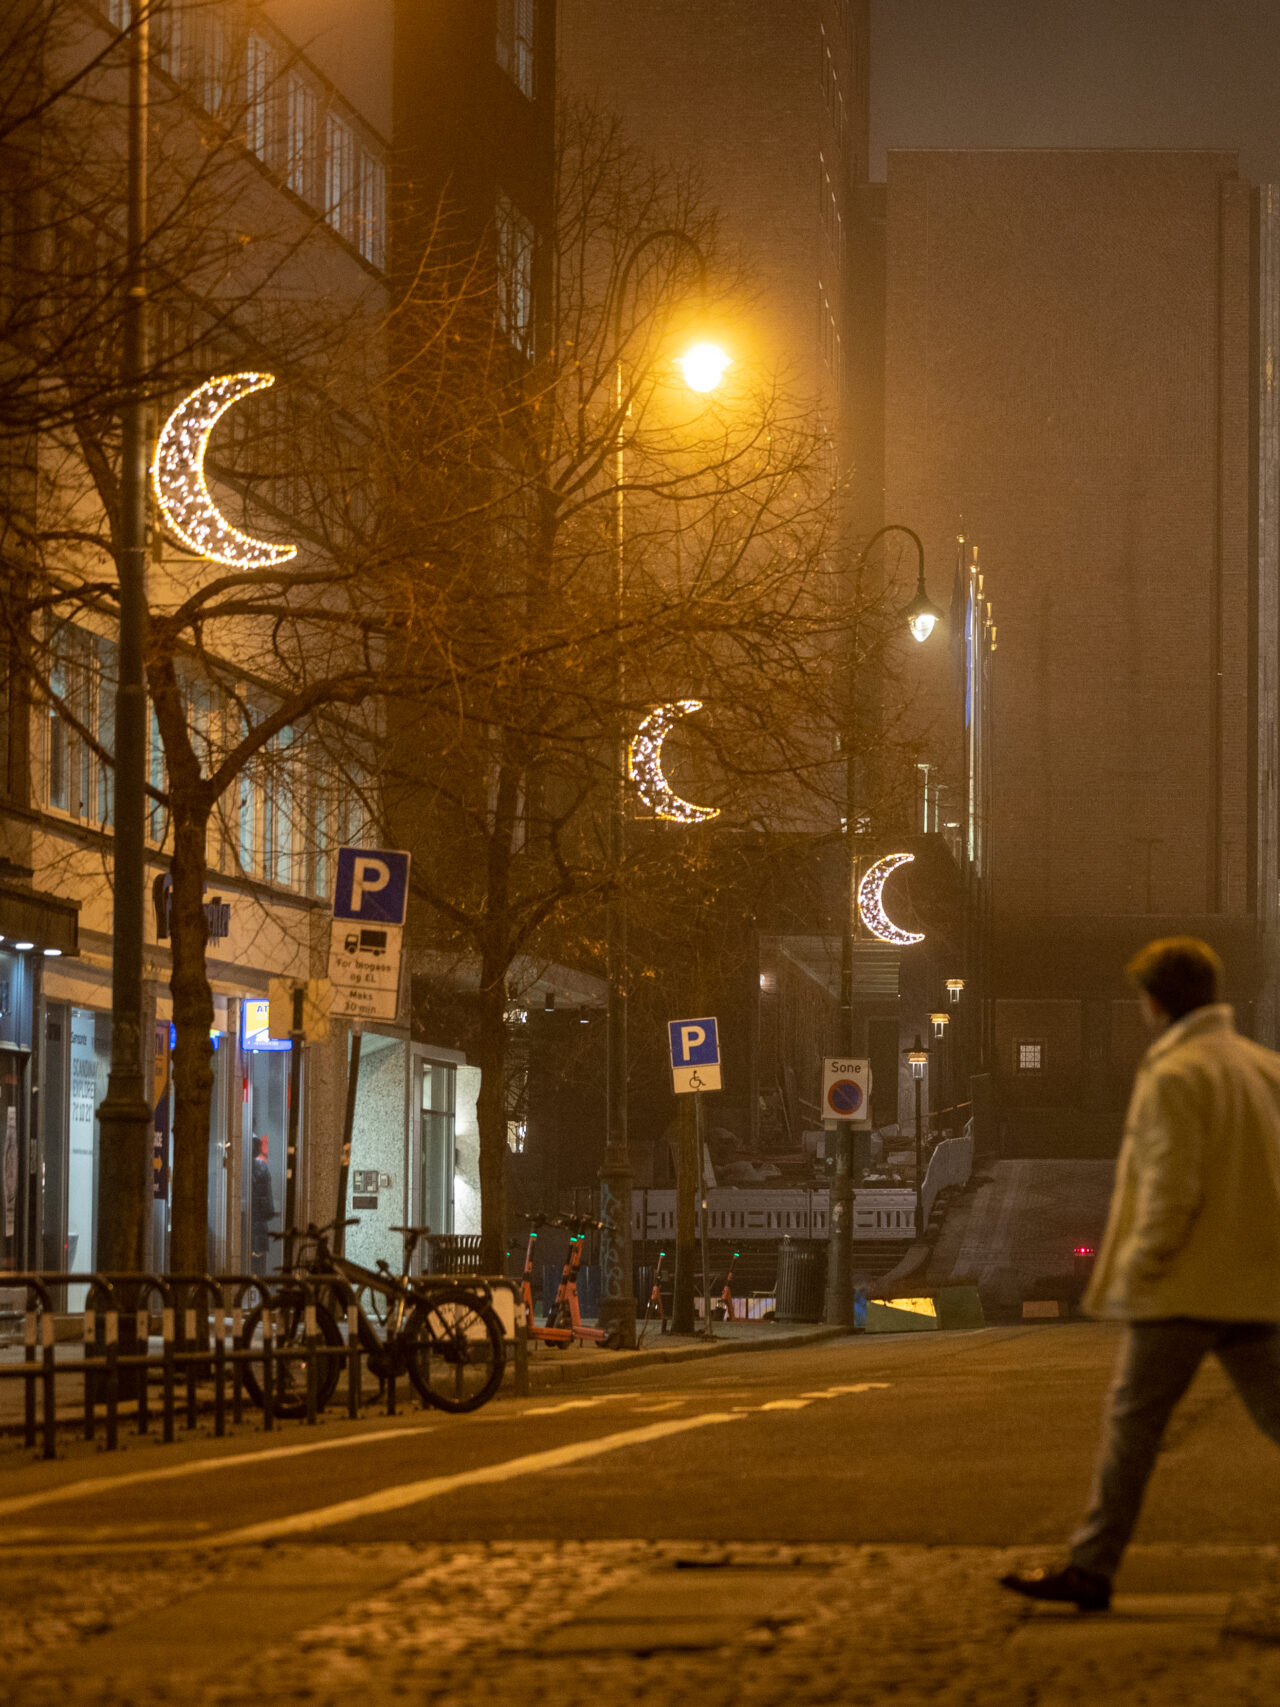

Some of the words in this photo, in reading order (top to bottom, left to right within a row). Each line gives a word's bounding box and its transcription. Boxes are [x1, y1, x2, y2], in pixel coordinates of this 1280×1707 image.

[350, 857, 390, 912] P
[681, 1025, 706, 1061] P
[831, 1061, 862, 1073] Sone
